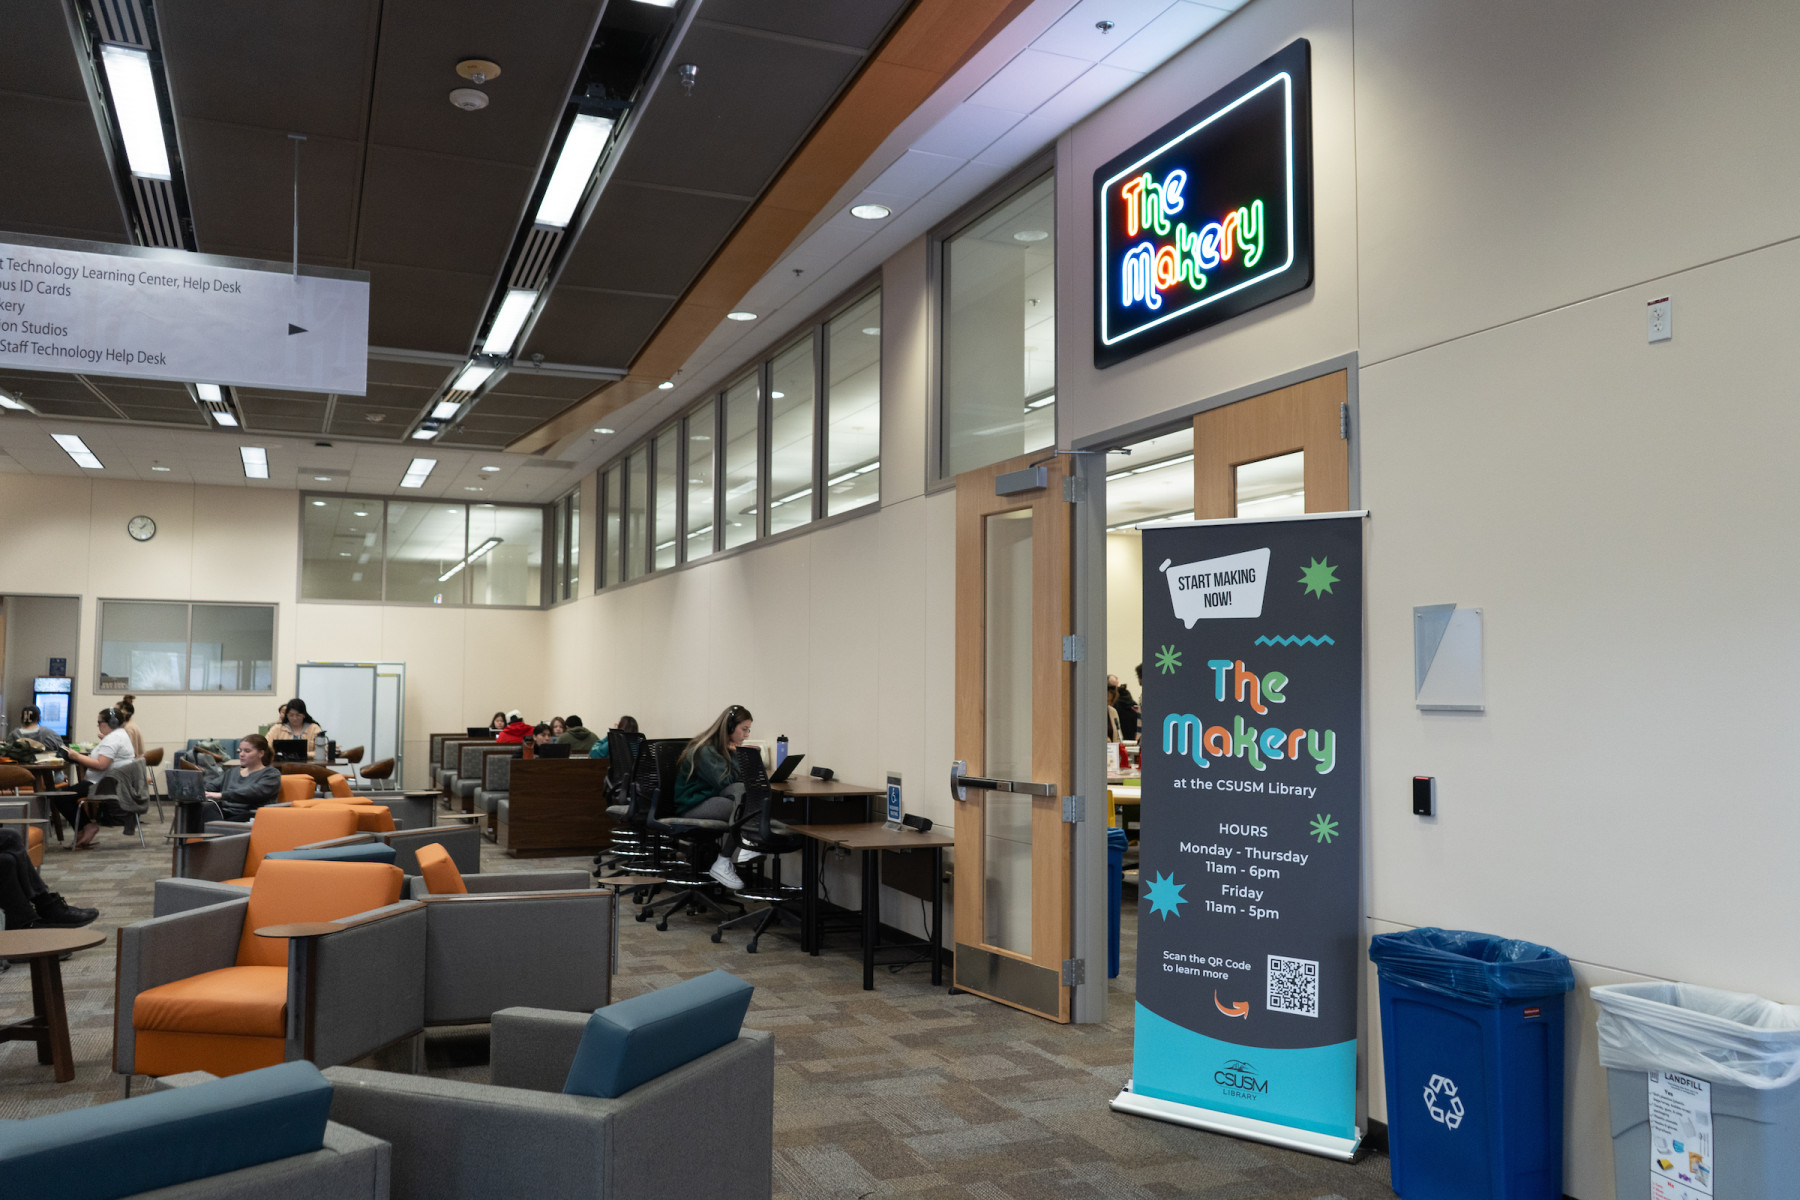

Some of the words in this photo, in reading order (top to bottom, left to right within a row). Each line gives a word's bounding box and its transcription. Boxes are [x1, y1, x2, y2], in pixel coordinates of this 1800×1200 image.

[1121, 168, 1188, 236] The
[6, 257, 79, 280] Technology
[82, 265, 135, 286] Learning
[138, 271, 180, 289] Center,
[183, 275, 211, 293] Help
[213, 279, 241, 294] Desk
[0, 280, 16, 291] us
[20, 279, 33, 293] ID
[36, 281, 71, 297] Cards
[21, 320, 68, 337] Studios
[0, 339, 29, 354] Staff
[31, 341, 102, 363] Technology
[106, 348, 134, 365] Help
[137, 350, 166, 365] Desk
[1178, 573, 1211, 591] START
[1213, 568, 1256, 588] MAKING
[1203, 590, 1232, 608] NOW!
[1207, 659, 1289, 715] The
[1173, 778, 1187, 789] at
[1190, 778, 1213, 790] the
[1216, 779, 1264, 794] CSUSM
[1268, 781, 1317, 799] Library
[1219, 823, 1268, 838] HOURS
[1179, 841, 1233, 859] Monday
[1245, 846, 1309, 866] Thursday
[1205, 860, 1237, 875] 11am
[1249, 865, 1280, 880] 6pm
[1221, 884, 1264, 901] Friday
[1205, 900, 1236, 915] 11am
[1248, 904, 1279, 920] 5pm
[1163, 950, 1187, 962] Scan
[1189, 953, 1206, 964] the
[1208, 956, 1223, 968] QR
[1225, 959, 1251, 971] Code
[1163, 963, 1173, 972] to
[1175, 963, 1200, 976] learn
[1202, 969, 1229, 980] more
[1214, 1070, 1268, 1094] CSUSM
[1664, 1071, 1703, 1091] LANDFILL
[1222, 1088, 1257, 1101] LIBRARY
